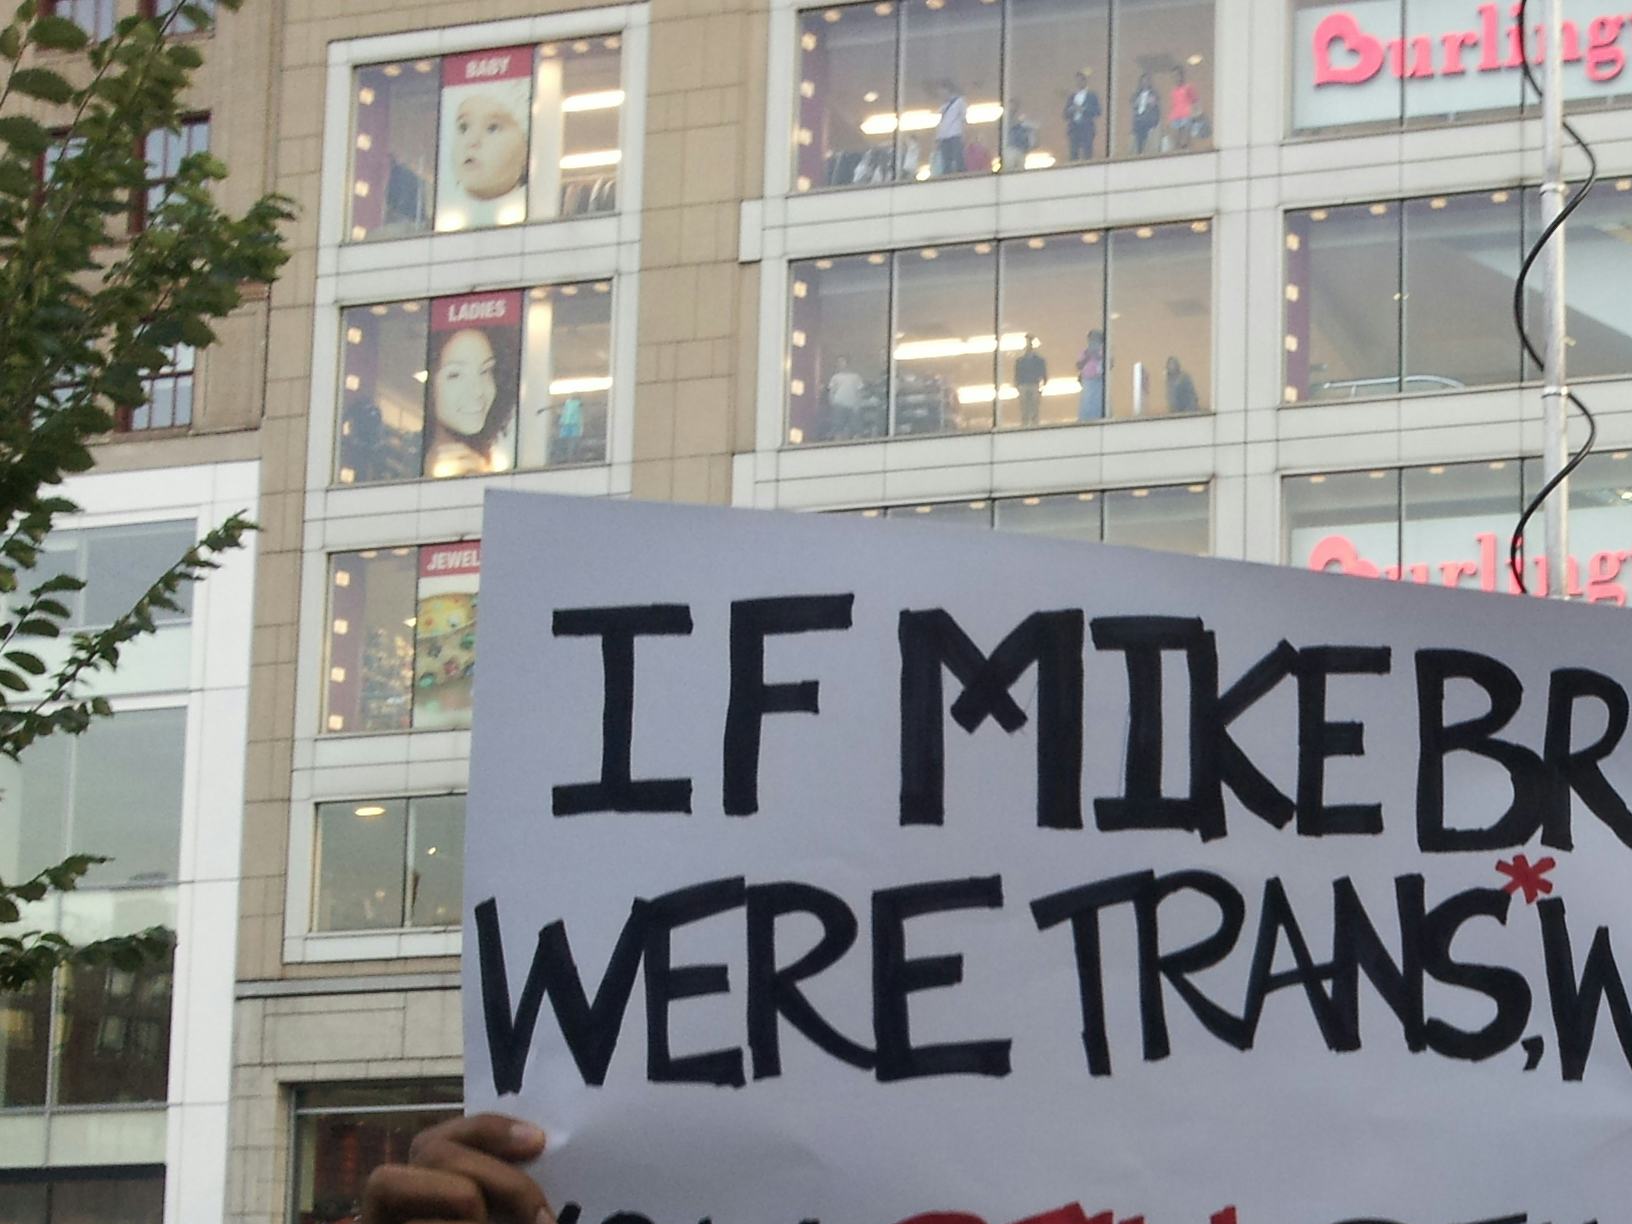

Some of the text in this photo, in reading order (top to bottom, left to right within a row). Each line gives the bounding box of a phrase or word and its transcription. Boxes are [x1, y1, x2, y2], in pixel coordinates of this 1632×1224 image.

[465, 56, 511, 79] BABY
[448, 299, 506, 323] LADIES
[552, 593, 854, 817] IF
[898, 607, 1392, 843] MIKE
[474, 875, 1013, 1097] WERE
